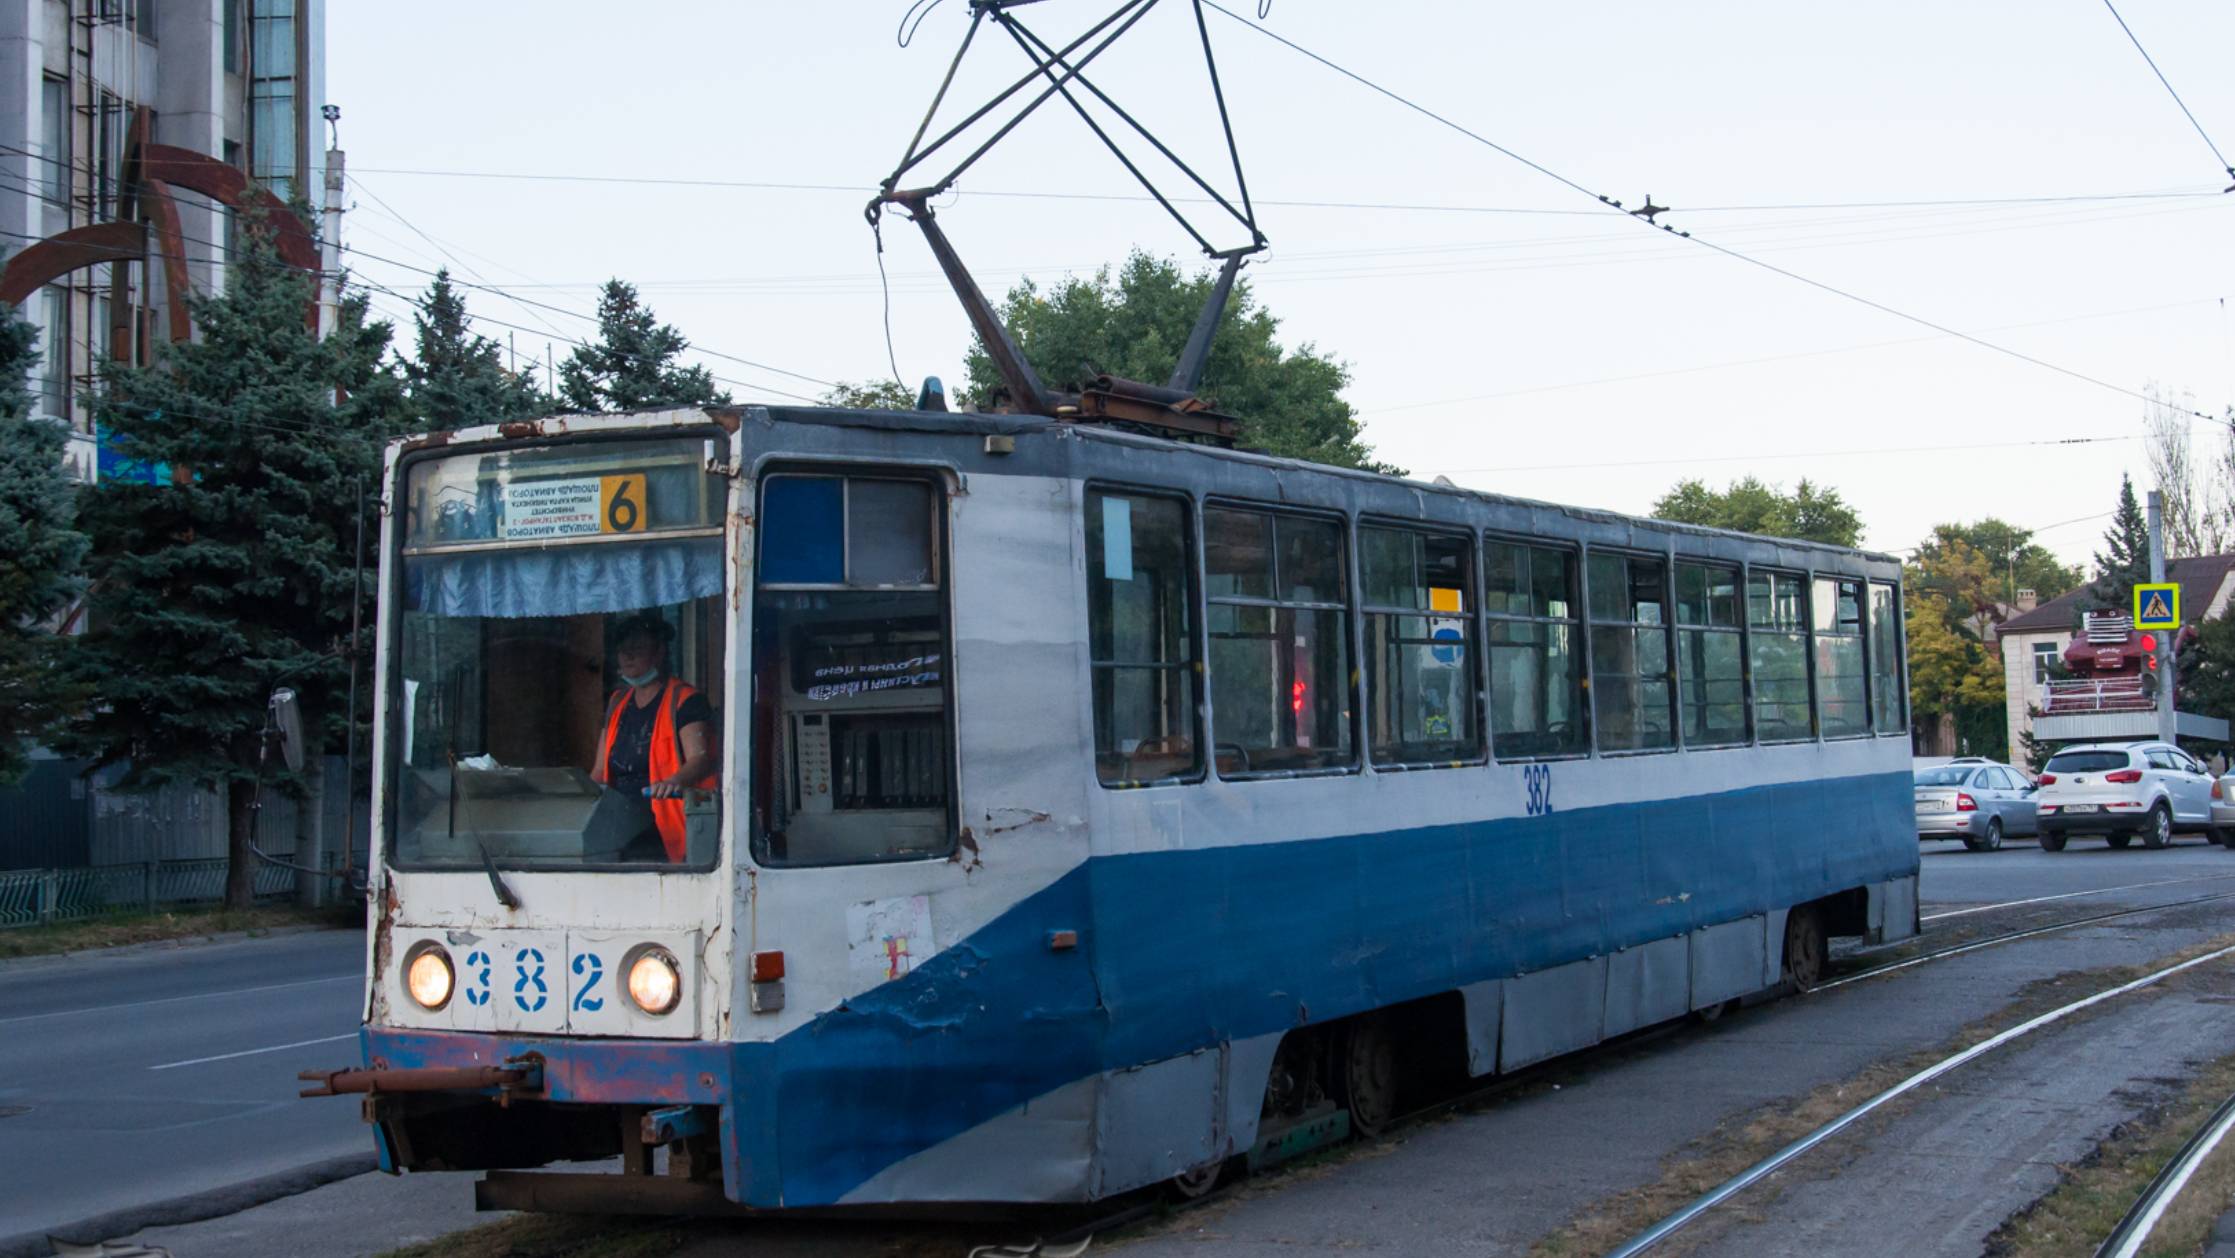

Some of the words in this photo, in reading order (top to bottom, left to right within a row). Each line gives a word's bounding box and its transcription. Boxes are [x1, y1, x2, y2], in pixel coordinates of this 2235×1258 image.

[558, 484, 599, 495] ПЛОЩАДЬ
[531, 506, 576, 516] УНИВЕРСИТЕТ
[506, 526, 556, 537] АВИАТОРОВ
[558, 523, 601, 534] ПЛОЩАДЬ
[1524, 764, 1552, 816] 382
